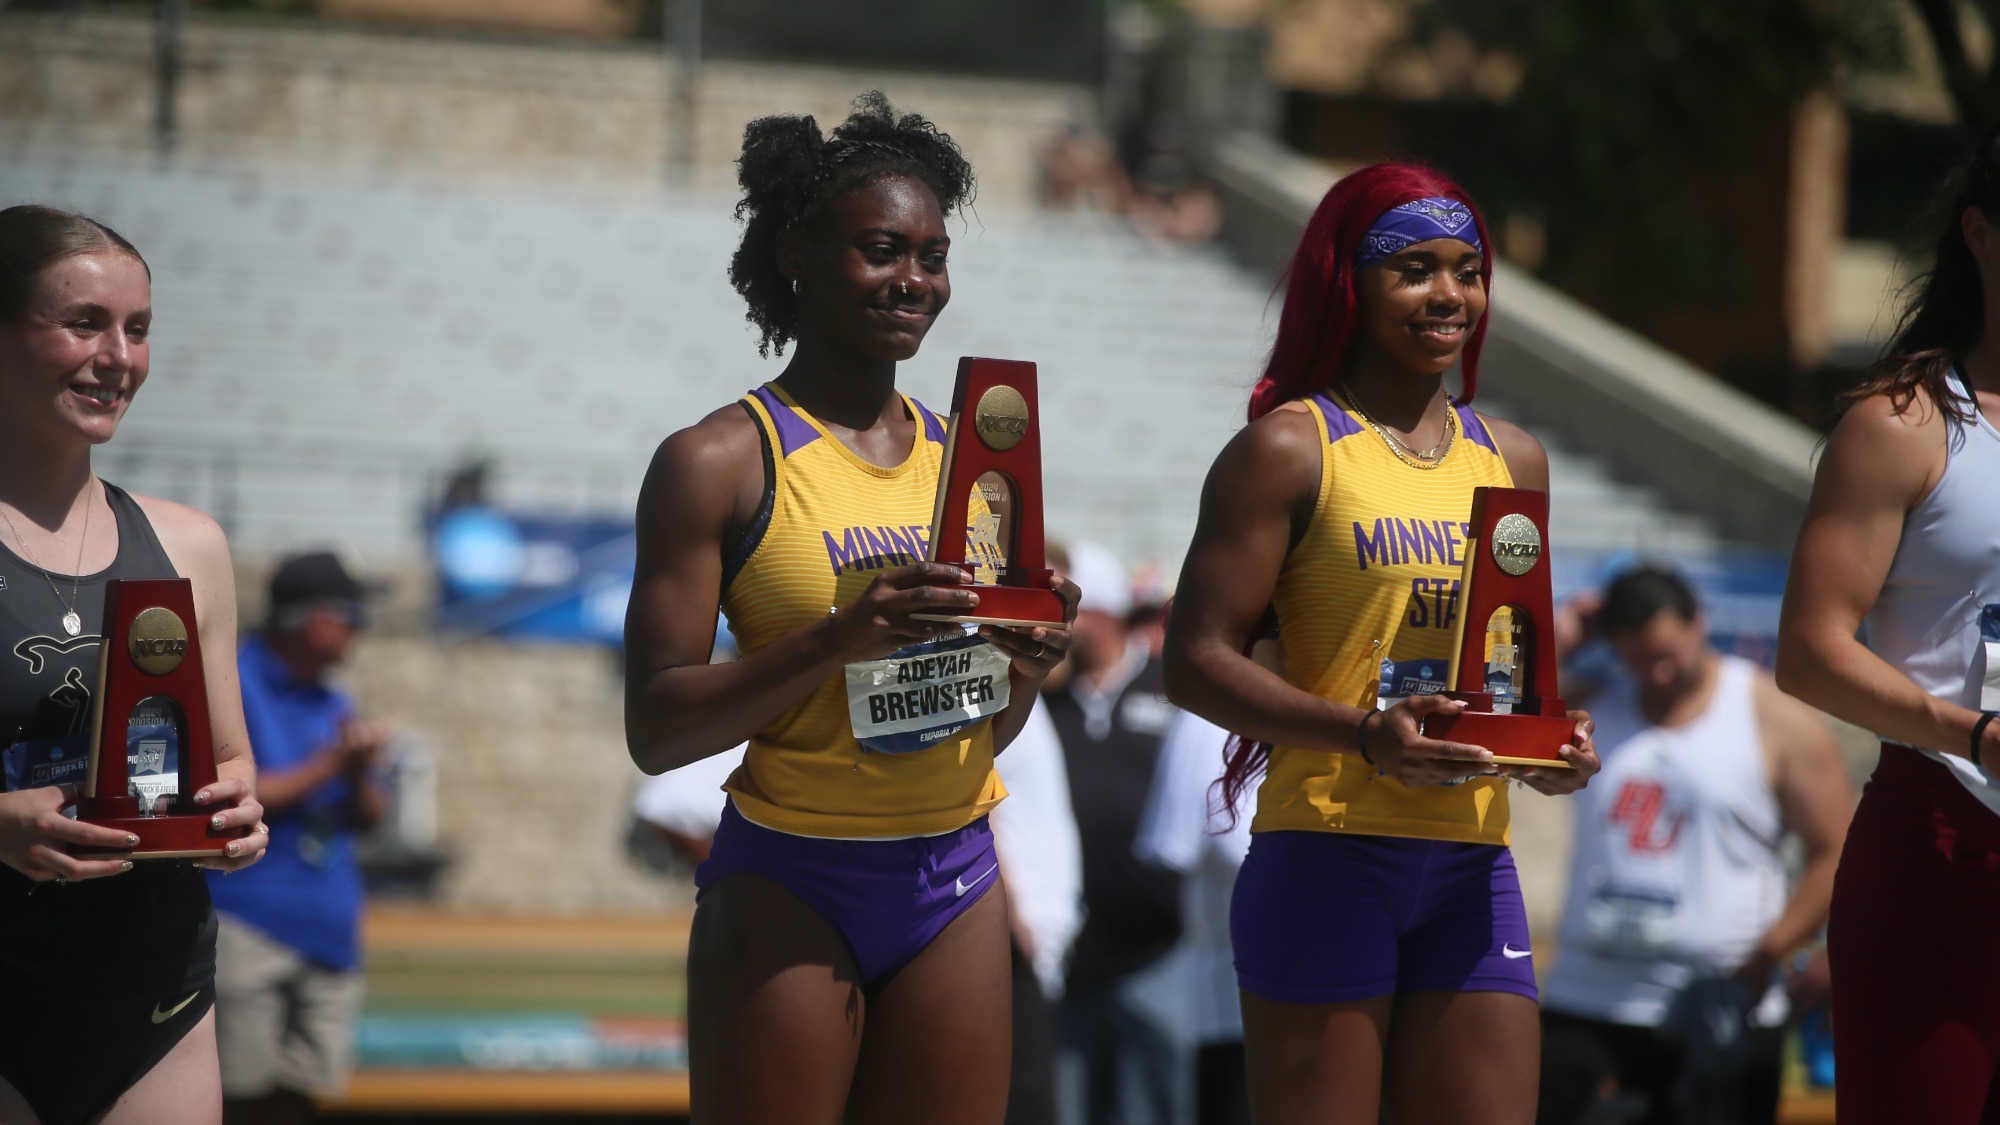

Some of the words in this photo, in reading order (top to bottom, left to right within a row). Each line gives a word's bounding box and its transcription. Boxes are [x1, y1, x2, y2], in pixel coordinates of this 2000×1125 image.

[980, 413, 1026, 435] NCAA
[980, 482, 999, 492] 2024
[822, 525, 932, 577] MINNE
[1494, 539, 1540, 558] NCAA
[134, 637, 187, 658] NCAA
[897, 652, 972, 684] ADEYAH
[868, 675, 995, 724] BREWSTER
[130, 718, 165, 727] DIVISION
[50, 762, 77, 776] TRACK
[160, 785, 176, 793] FIELD
